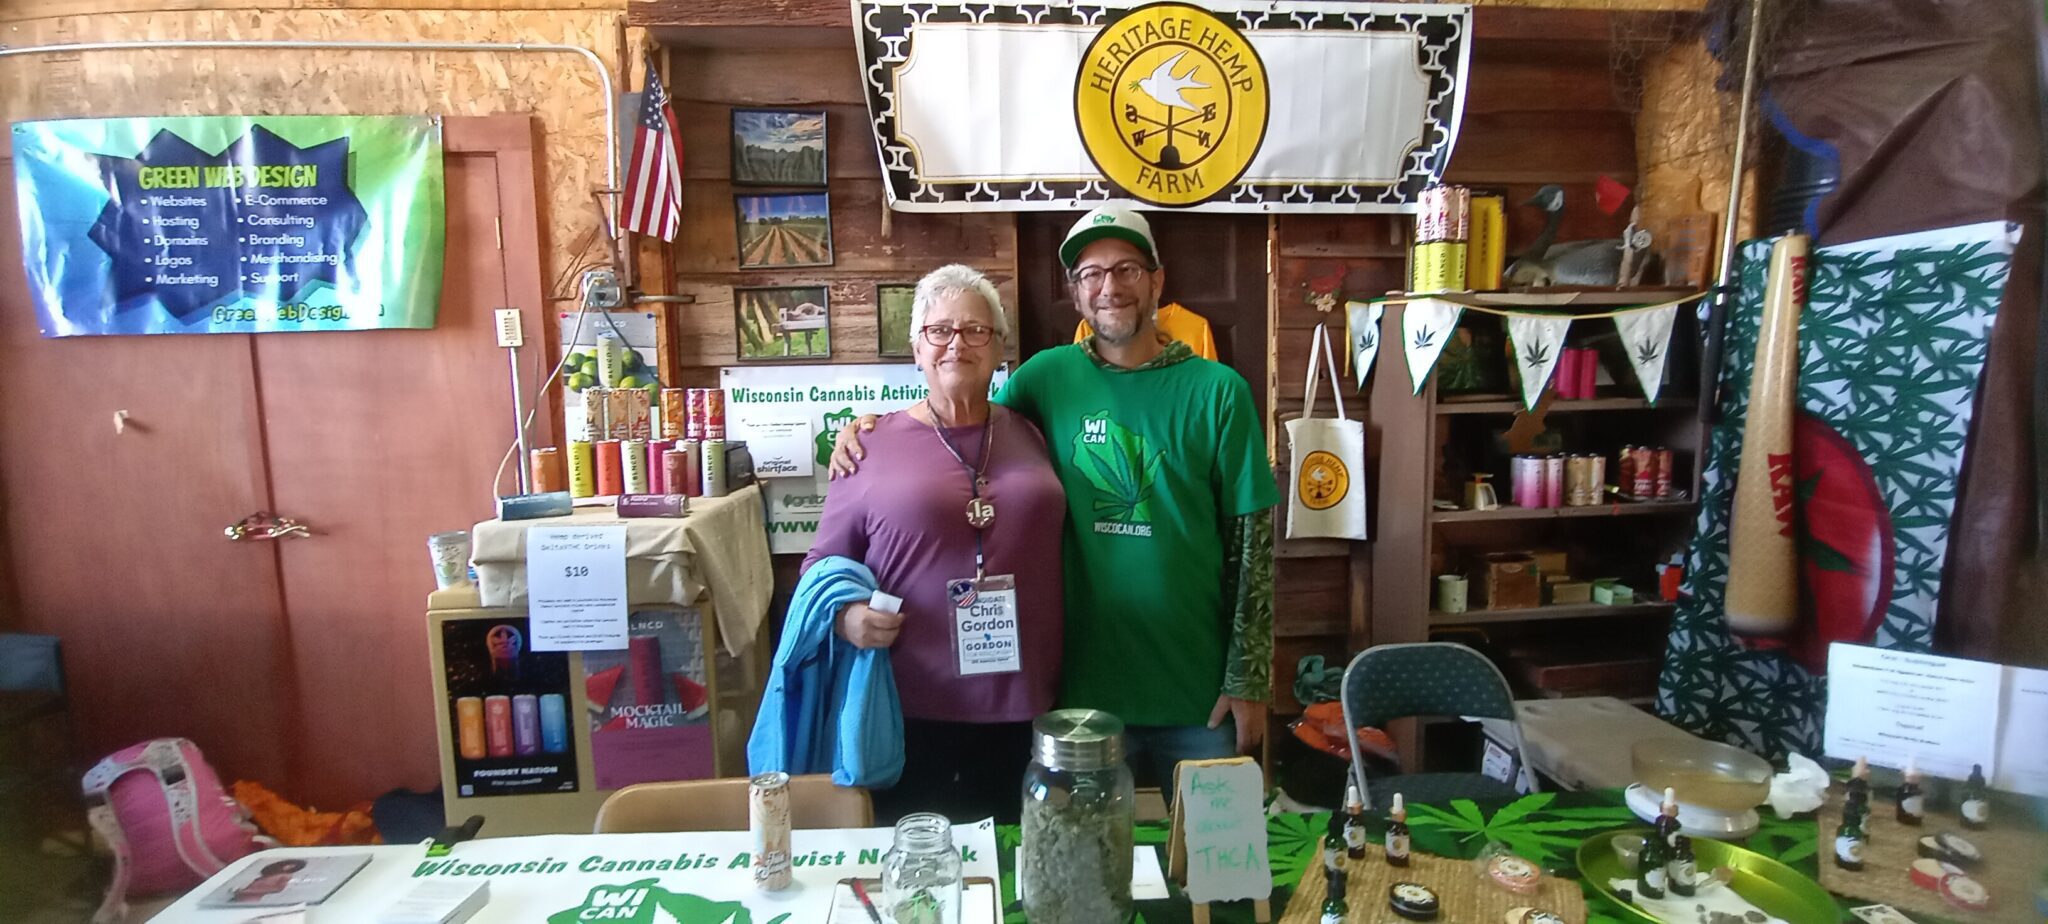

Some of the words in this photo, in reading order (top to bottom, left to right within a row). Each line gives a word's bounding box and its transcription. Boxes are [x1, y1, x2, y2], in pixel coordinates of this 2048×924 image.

[1090, 18, 1192, 94] HERITAGE
[1198, 27, 1253, 93] HEMP
[138, 167, 199, 190] GREEN
[204, 166, 246, 188] WEB
[247, 165, 318, 189] DESIGN
[1136, 165, 1205, 194] FARM
[150, 195, 207, 207] Websites
[245, 194, 328, 207] E-Commerce
[152, 215, 200, 229] Hosting
[247, 214, 315, 228] Consulting
[154, 235, 208, 247] Domains
[249, 233, 304, 248] Branding
[155, 255, 193, 268] Logos
[250, 252, 340, 266] Merchandising
[156, 274, 219, 287] Marketing
[731, 387, 804, 403] Wisconsin
[810, 384, 876, 402] Cannabis
[880, 384, 930, 401] Activis
[1084, 419, 1106, 434] WI
[1083, 434, 1106, 444] CAN
[756, 464, 799, 475] shirtface
[1094, 522, 1152, 537] WISCOCAN.ORG
[564, 566, 589, 578] $10
[970, 604, 1004, 618] Chris
[961, 618, 1015, 633] Gordon
[965, 641, 1012, 651] GORDON
[610, 703, 688, 718] MOCKTAIL
[625, 715, 674, 729] MAGIC
[473, 767, 520, 780] FOUNDRY
[520, 765, 559, 777] NATION
[1191, 771, 1234, 796] Ask
[411, 857, 569, 878] Wisconsin
[578, 853, 720, 873] Cannabis
[727, 851, 848, 869] Avist
[592, 888, 651, 906] WI
[578, 906, 639, 920] CAN
